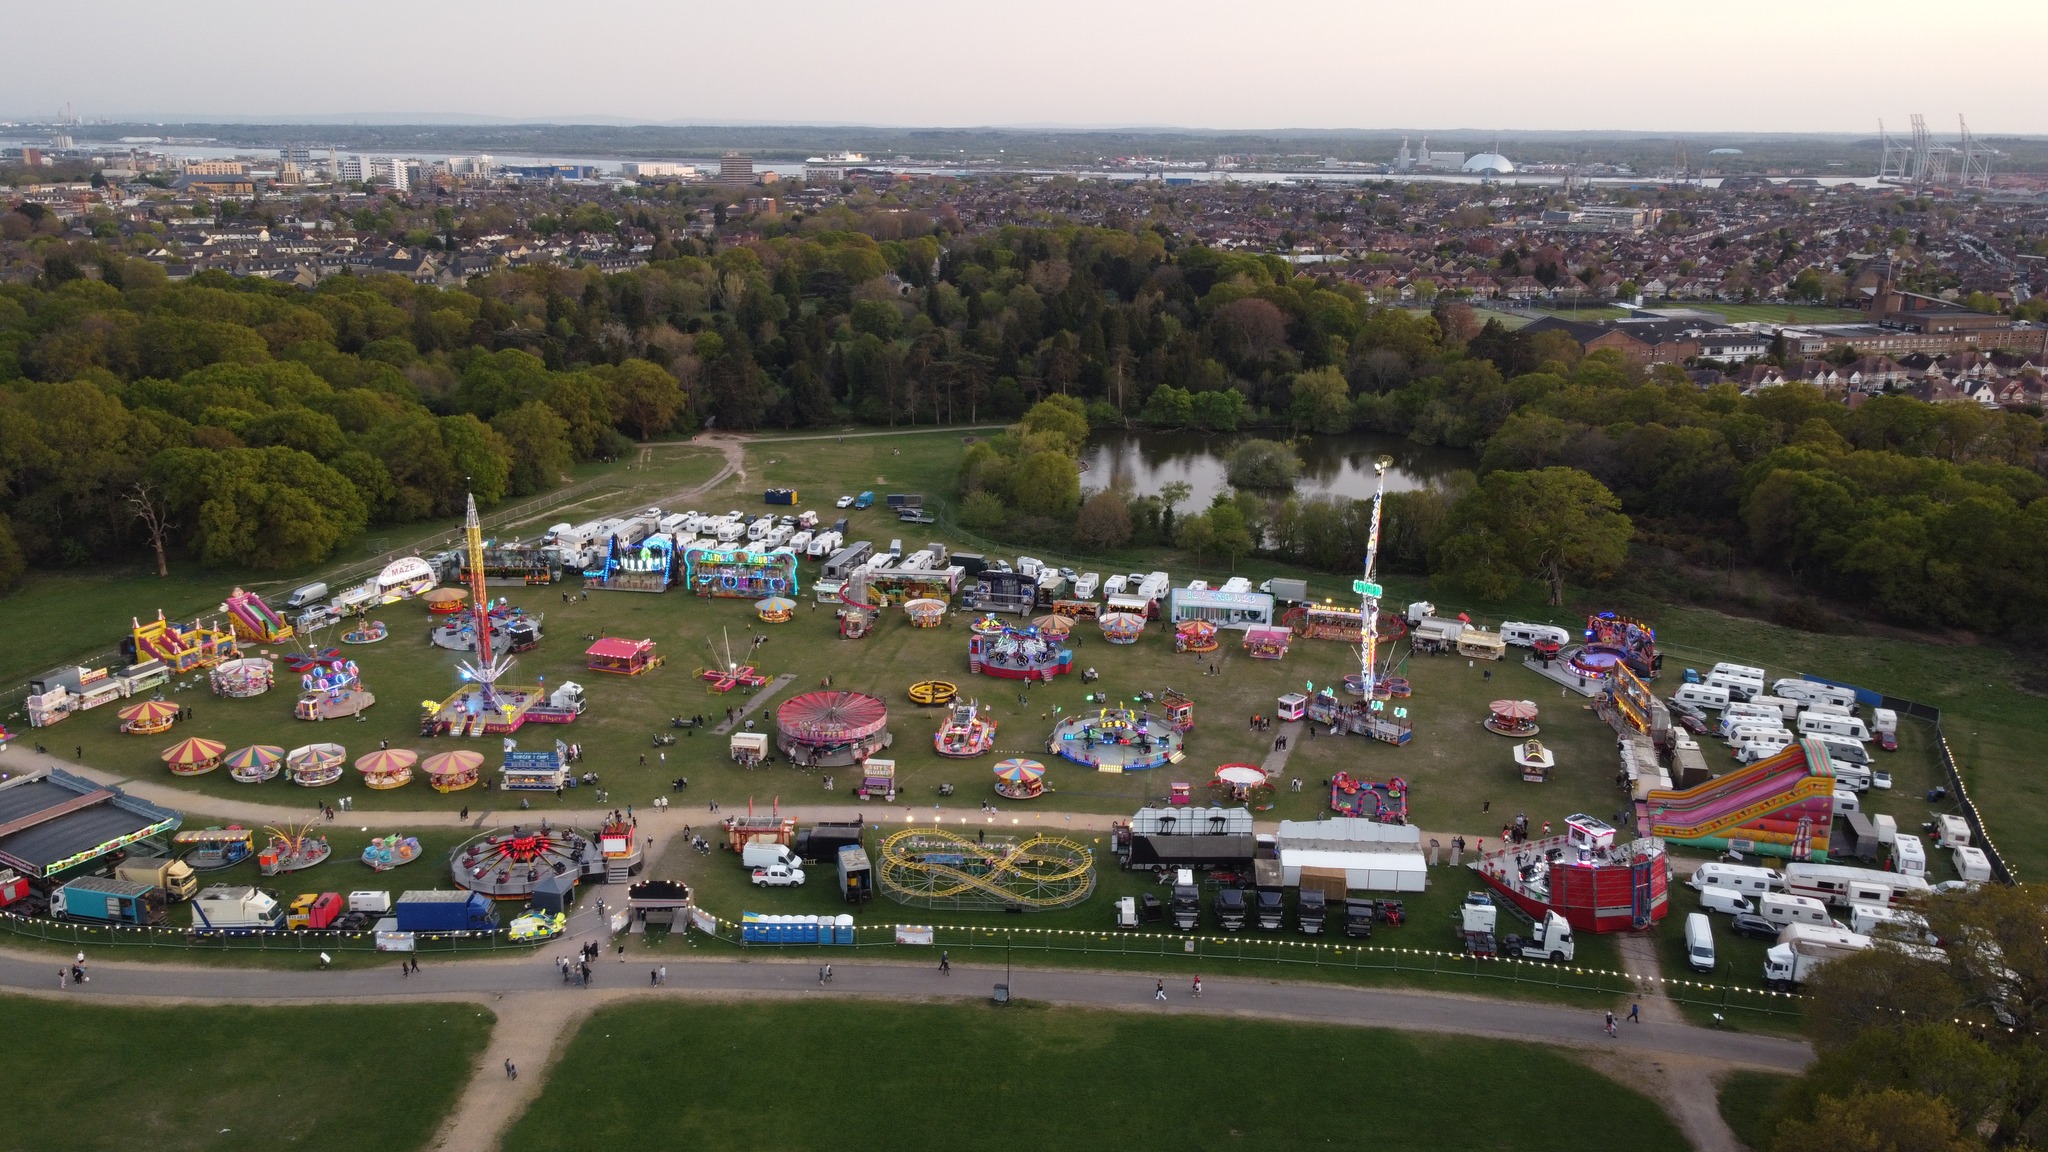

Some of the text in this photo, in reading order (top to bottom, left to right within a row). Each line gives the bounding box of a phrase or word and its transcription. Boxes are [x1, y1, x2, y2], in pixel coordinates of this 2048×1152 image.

[391, 562, 416, 577] MAZE
[90, 695, 111, 707] SWEETS
[540, 714, 563, 723] Flyer
[801, 729, 845, 741] WALTZER
